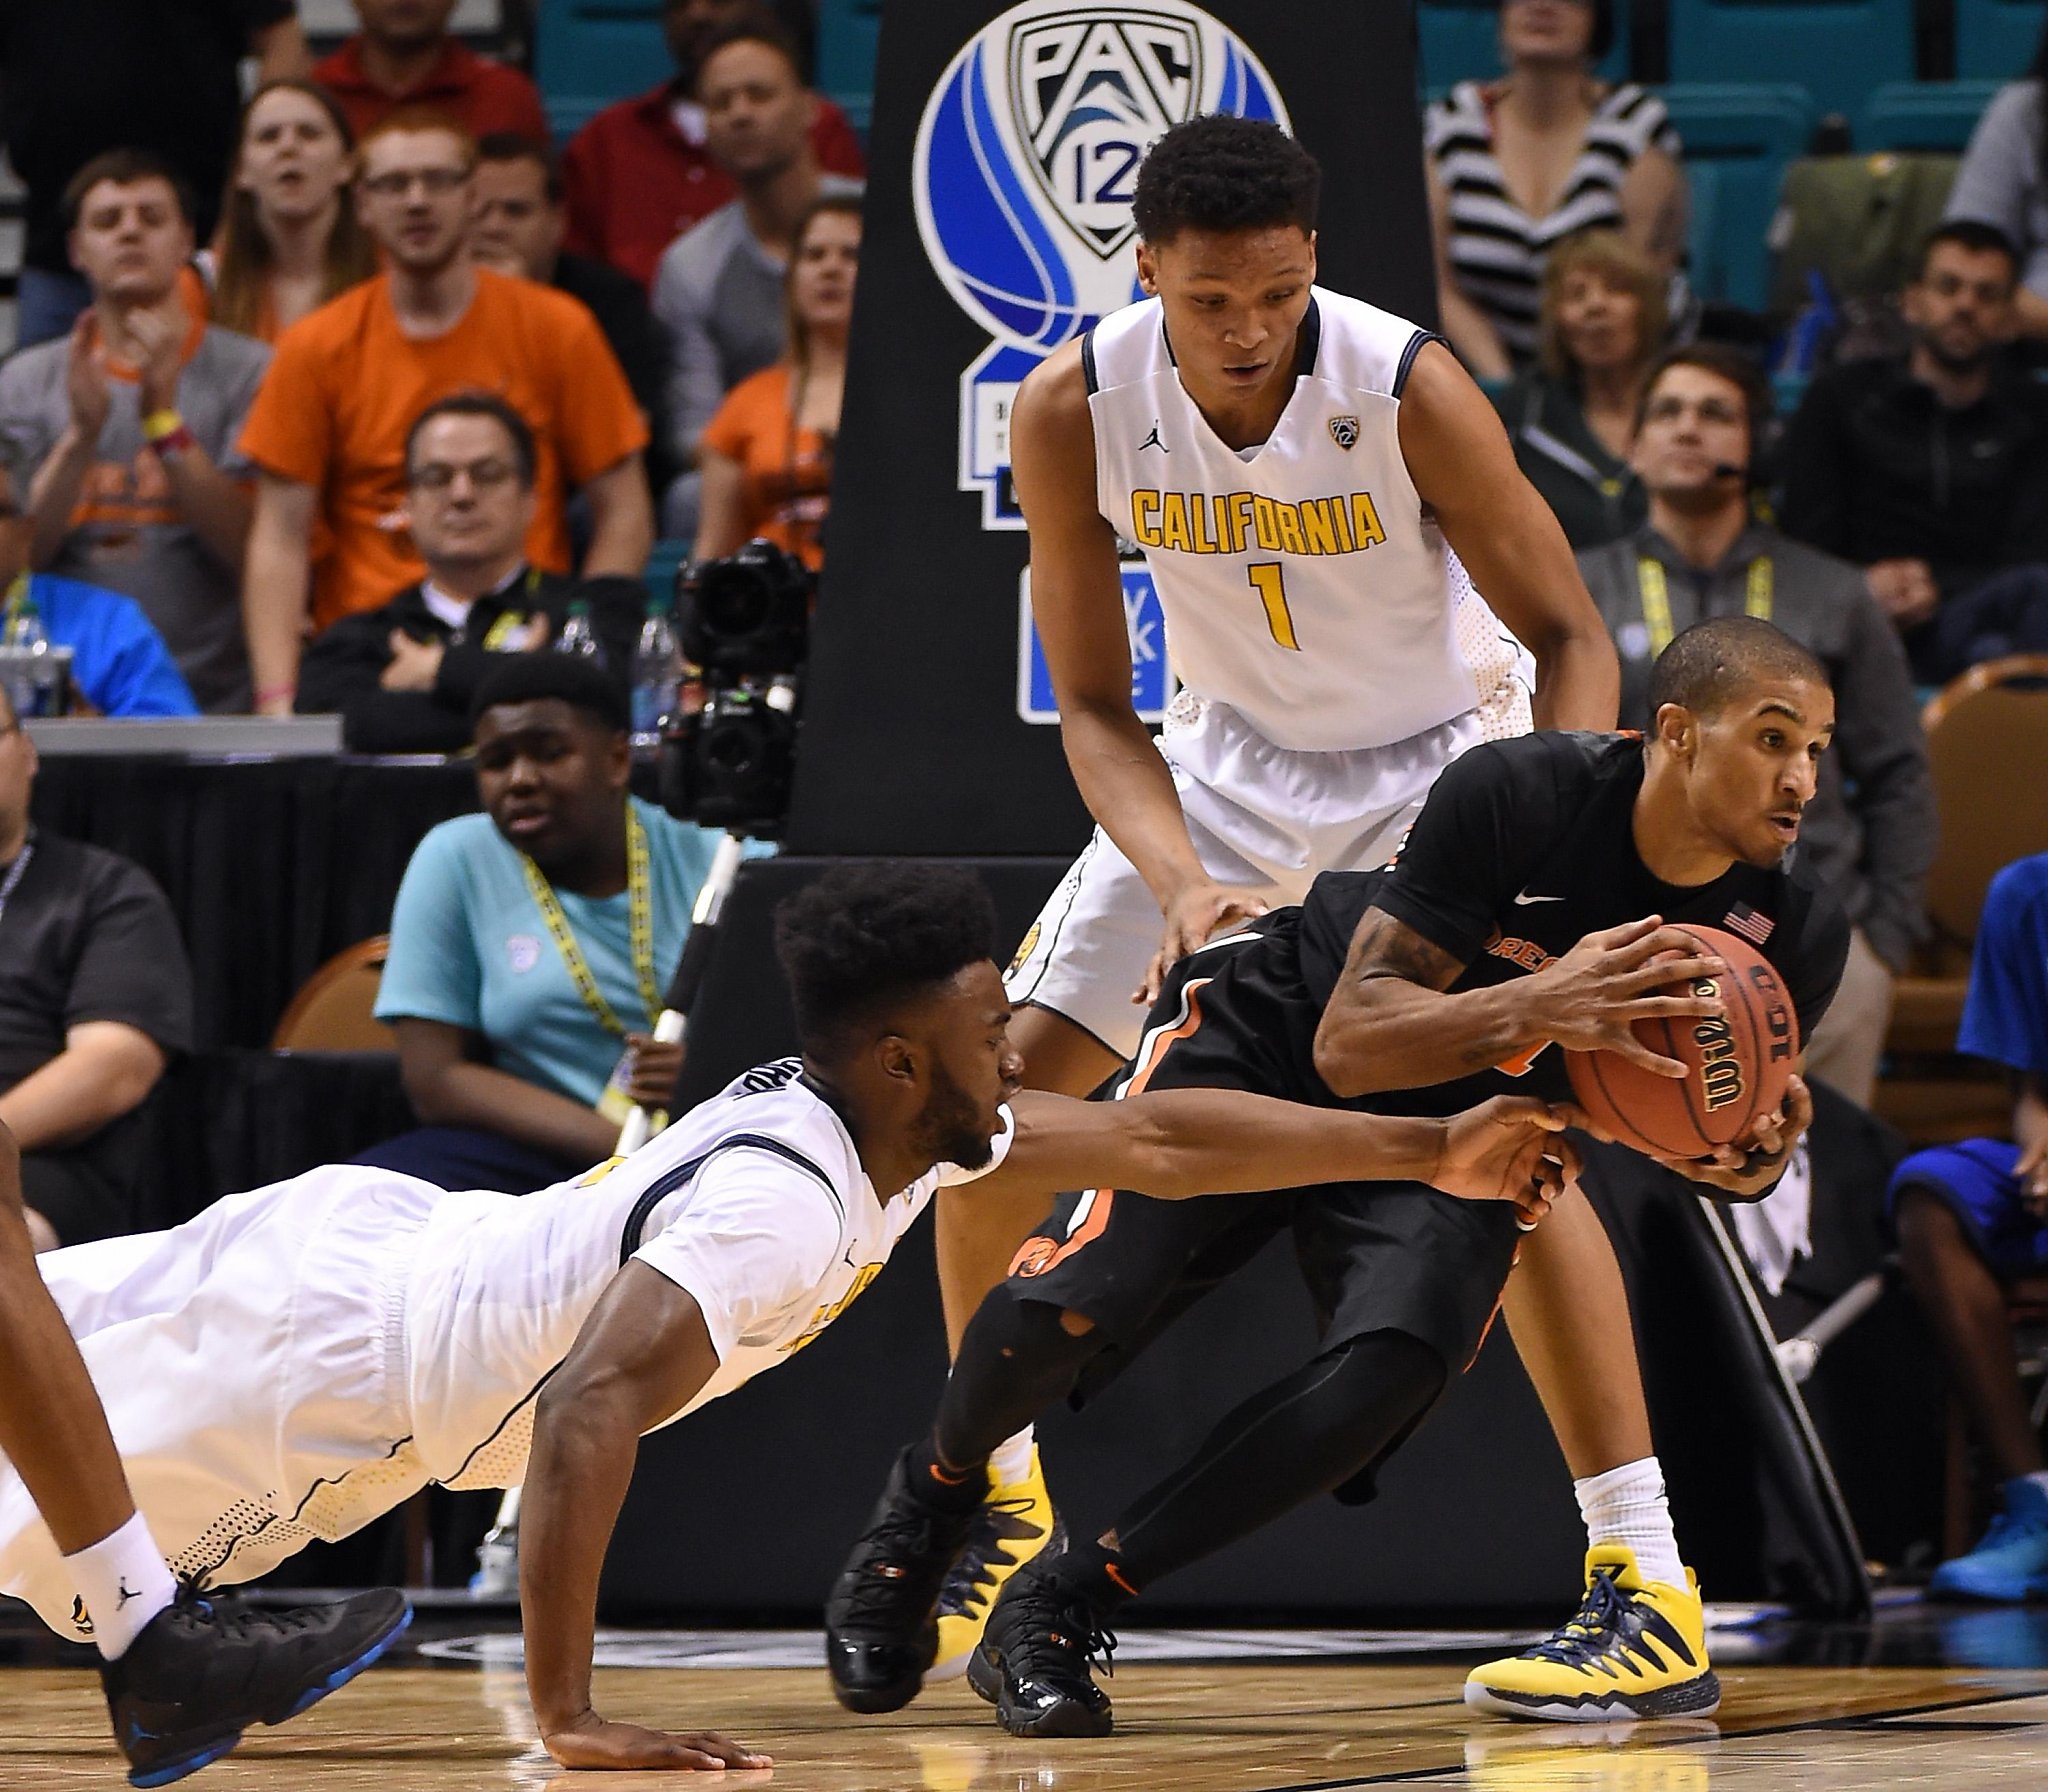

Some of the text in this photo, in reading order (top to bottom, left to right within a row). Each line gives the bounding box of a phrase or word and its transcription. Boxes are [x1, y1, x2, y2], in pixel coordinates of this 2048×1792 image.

[1020, 18, 1193, 150] PAC
[1074, 140, 1141, 204] 12
[1130, 488, 1387, 556] CALIFORNIA
[1247, 561, 1302, 652] 1
[1688, 978, 1744, 1113] Wilo
